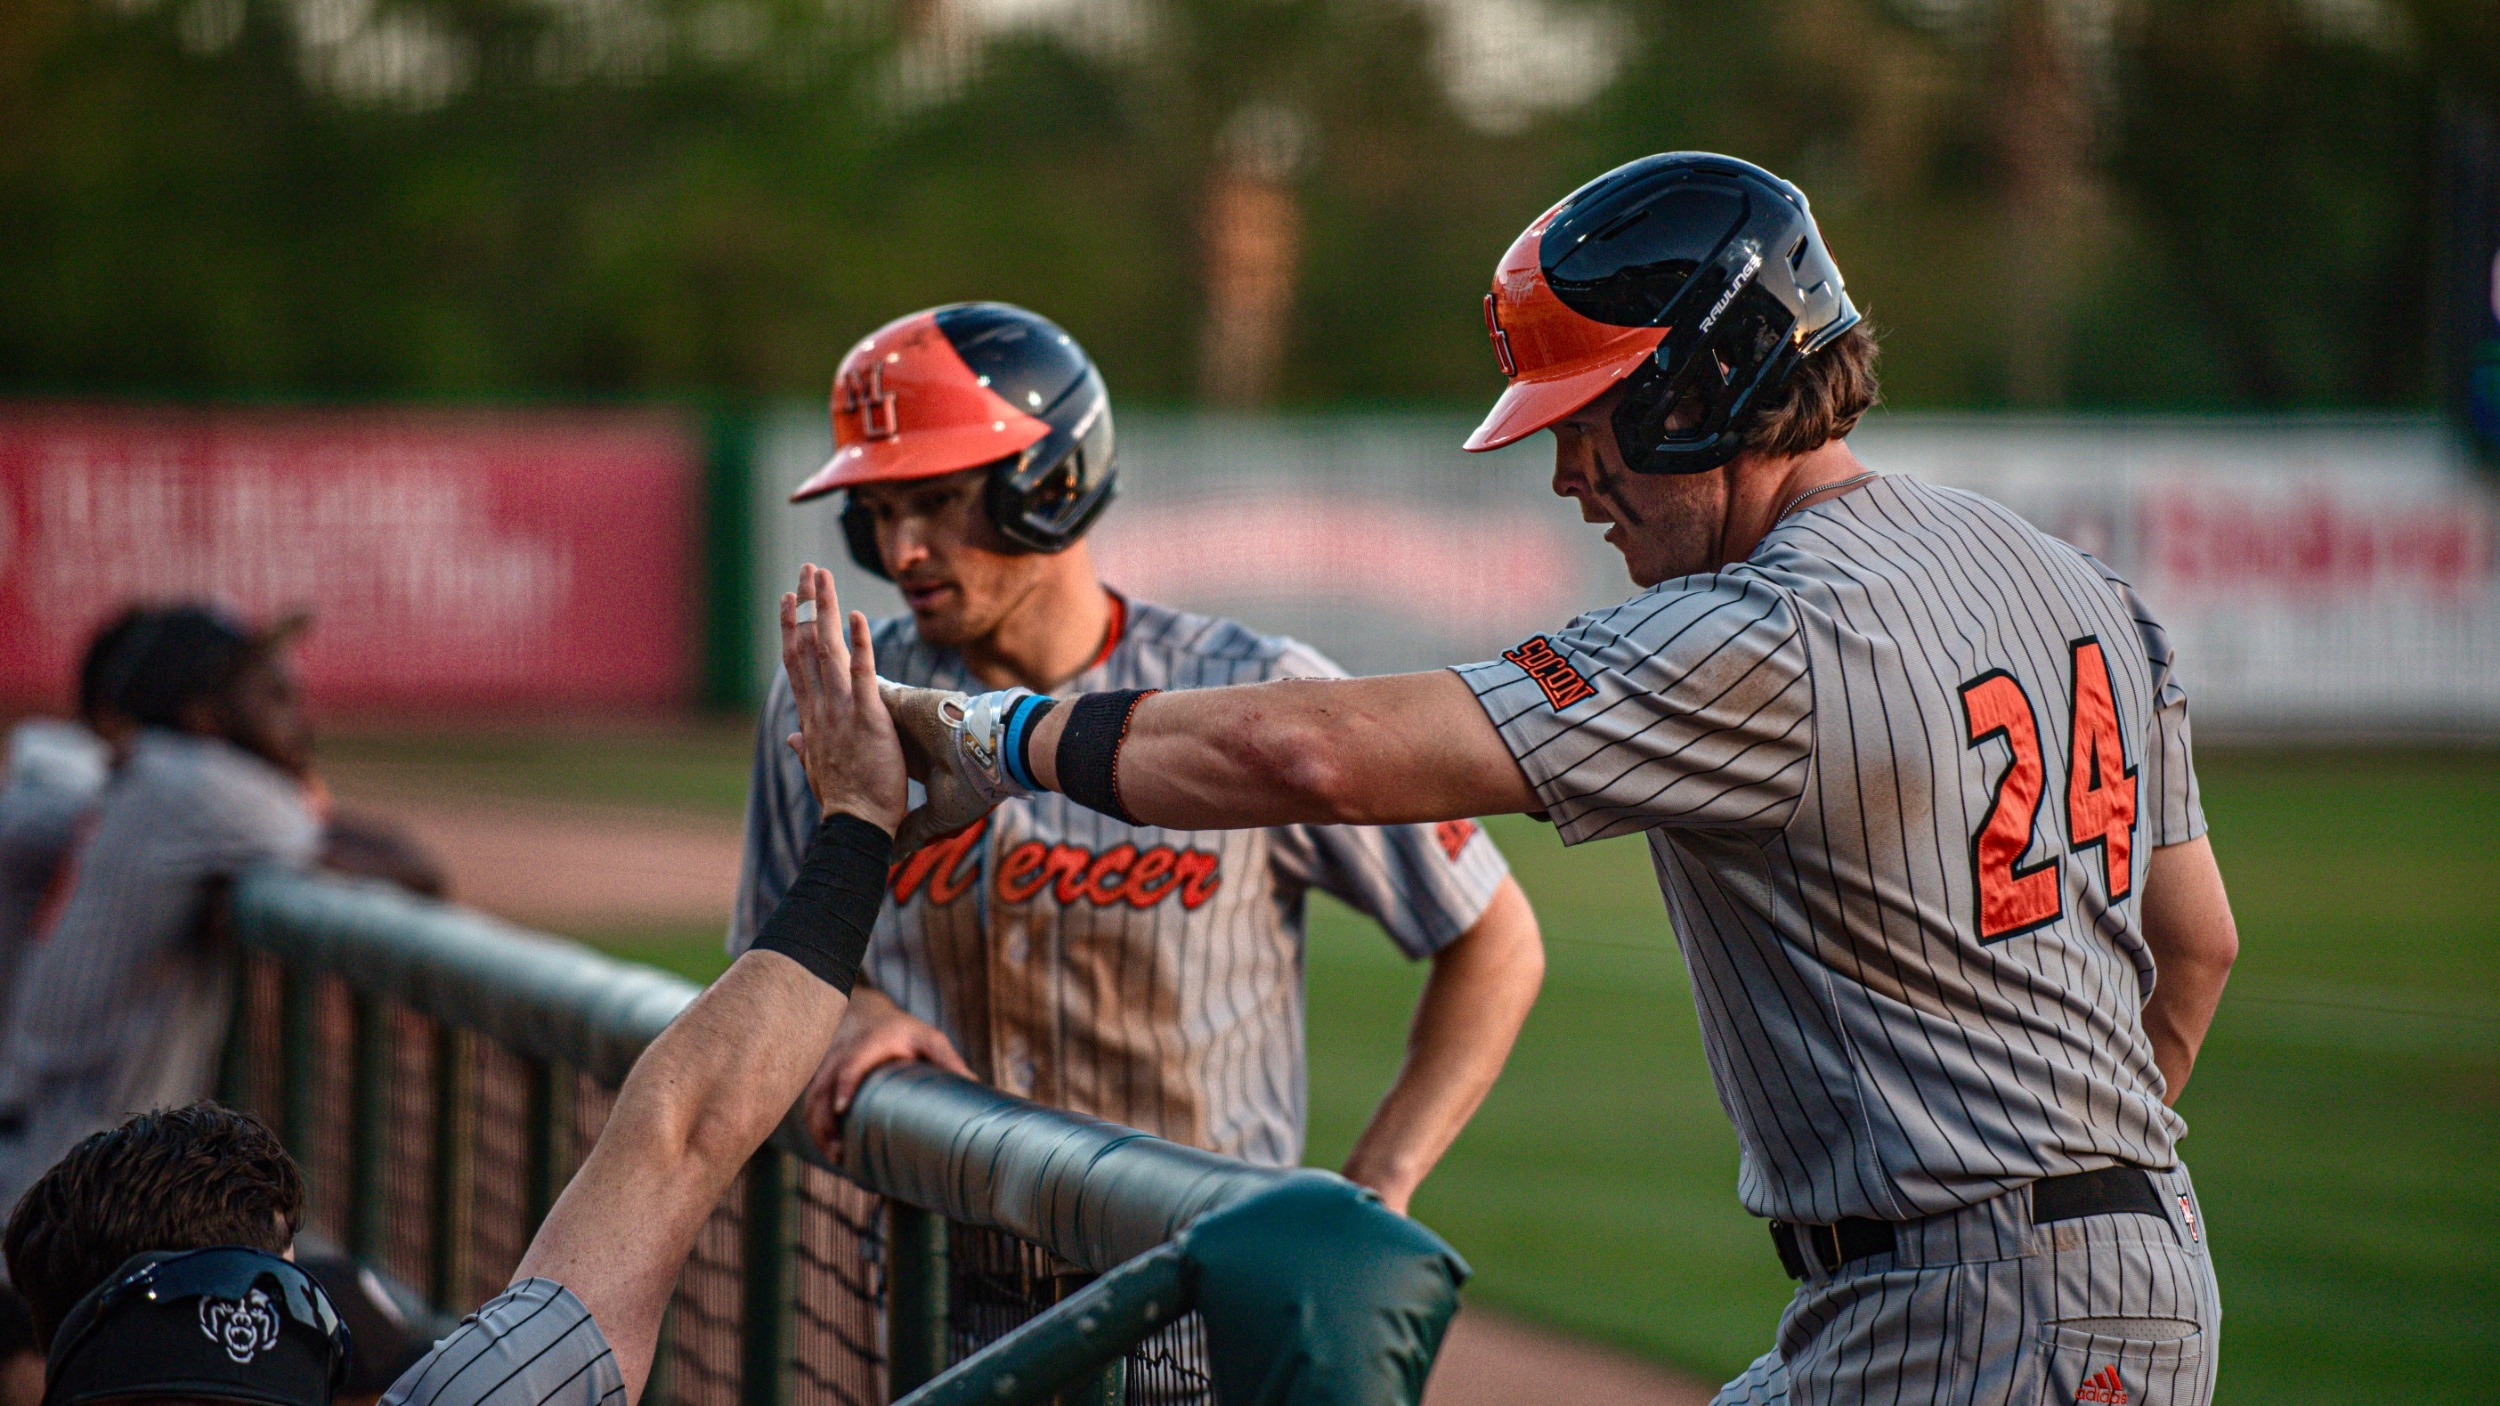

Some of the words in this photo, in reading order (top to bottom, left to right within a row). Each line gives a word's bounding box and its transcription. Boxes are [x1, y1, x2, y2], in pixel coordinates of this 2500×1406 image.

[1503, 636, 1598, 712] SOCON
[1957, 634, 2139, 947] 24
[885, 814, 1221, 910] Mercer
[2075, 1385, 2128, 1405] adidas
